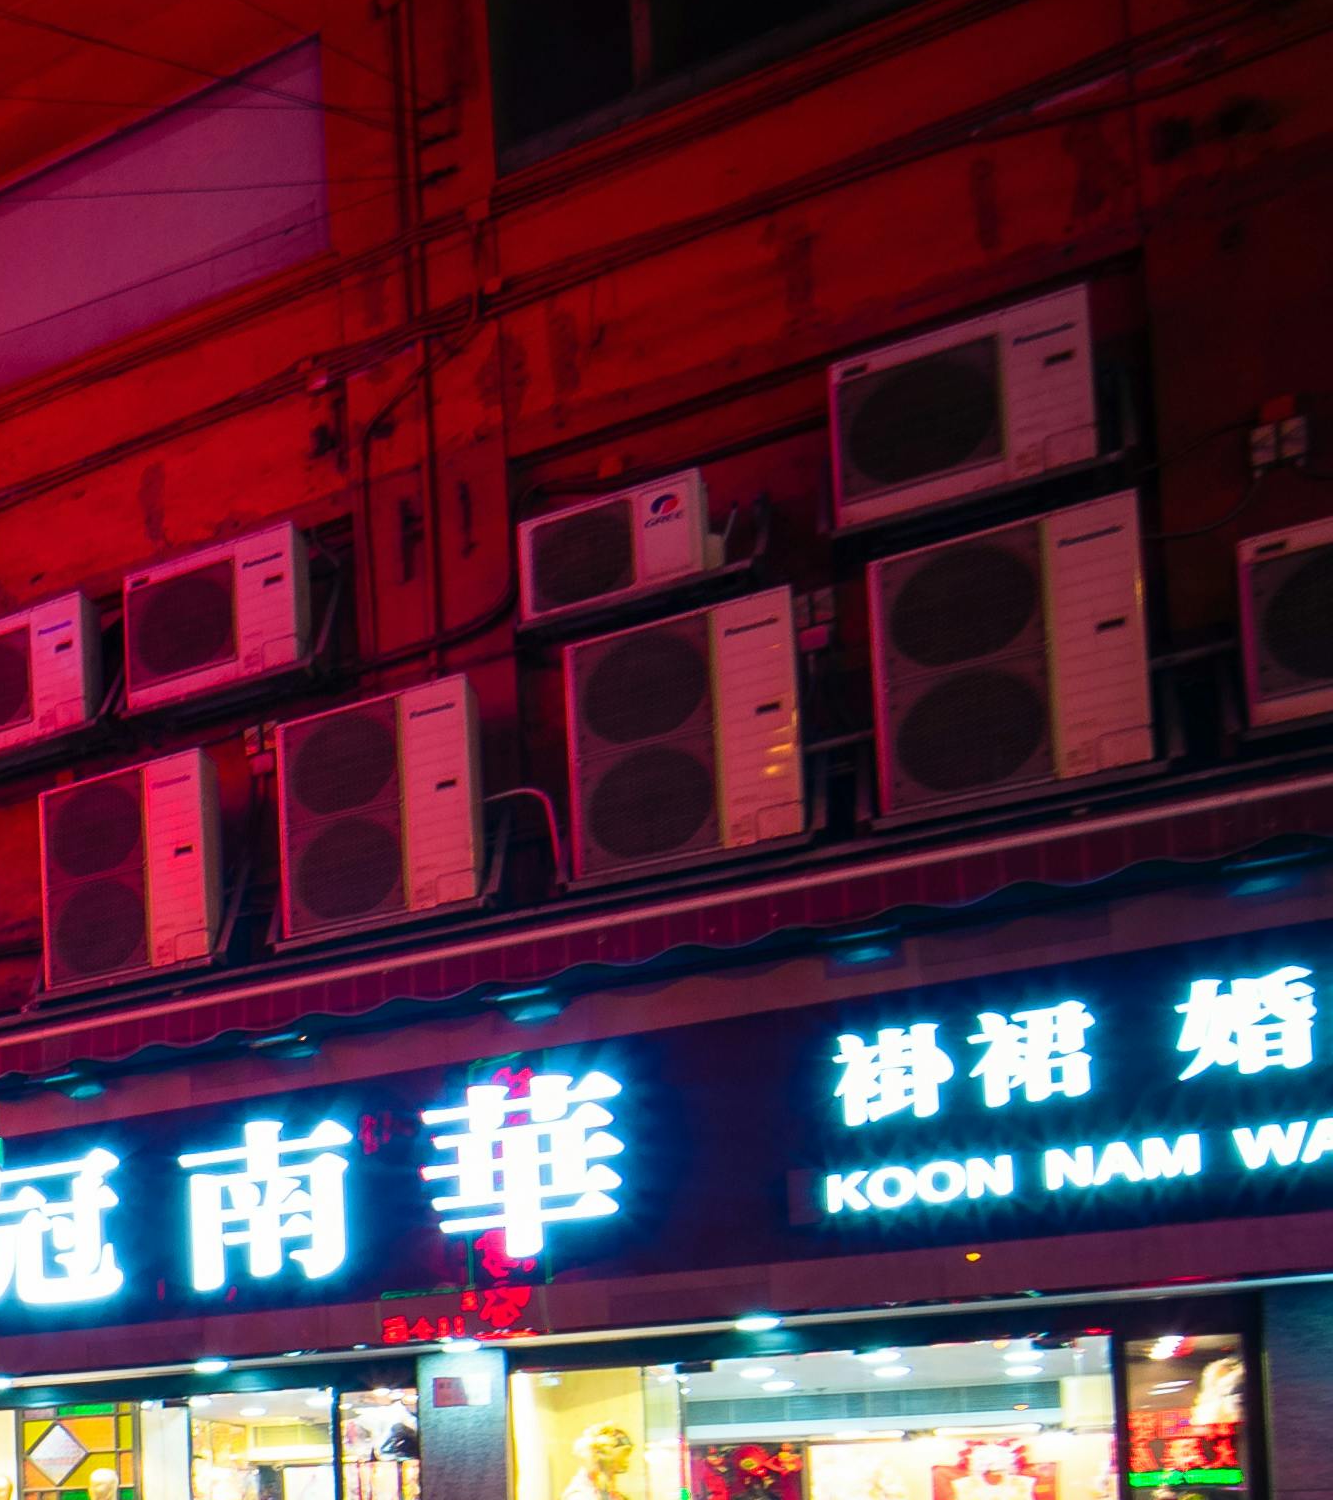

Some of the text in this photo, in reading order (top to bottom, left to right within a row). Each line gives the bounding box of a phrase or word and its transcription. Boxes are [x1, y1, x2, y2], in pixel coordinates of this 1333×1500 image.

[832, 965, 1317, 1127] 褂裙 婚
[825, 1117, 1333, 1213] KOON NAM WA
